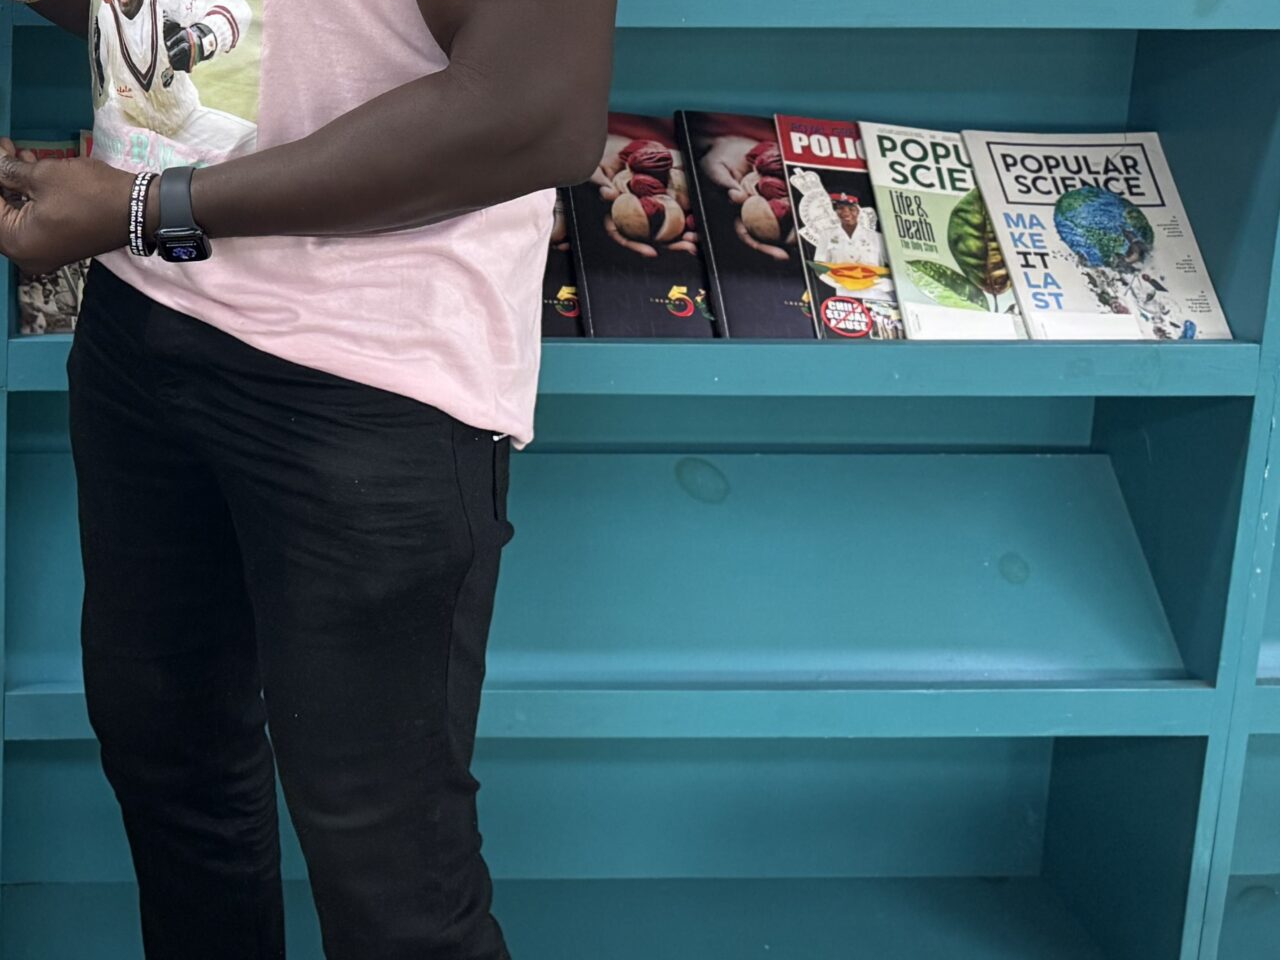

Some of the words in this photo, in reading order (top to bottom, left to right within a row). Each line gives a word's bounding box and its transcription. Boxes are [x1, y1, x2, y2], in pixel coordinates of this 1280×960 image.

[1001, 153, 1142, 176] POPULAR
[888, 161, 975, 192] SCIE
[1014, 173, 1146, 197] SCIENCE
[139, 185, 147, 200] rod
[888, 189, 915, 216] Life
[913, 195, 929, 218] &
[129, 200, 138, 232] through
[1004, 212, 1046, 230] MA
[894, 214, 936, 243] Death
[1009, 231, 1048, 250] KE
[1016, 251, 1049, 270] IT
[1023, 271, 1062, 289] LA
[827, 300, 863, 312] CHILD
[1031, 292, 1064, 309] ST
